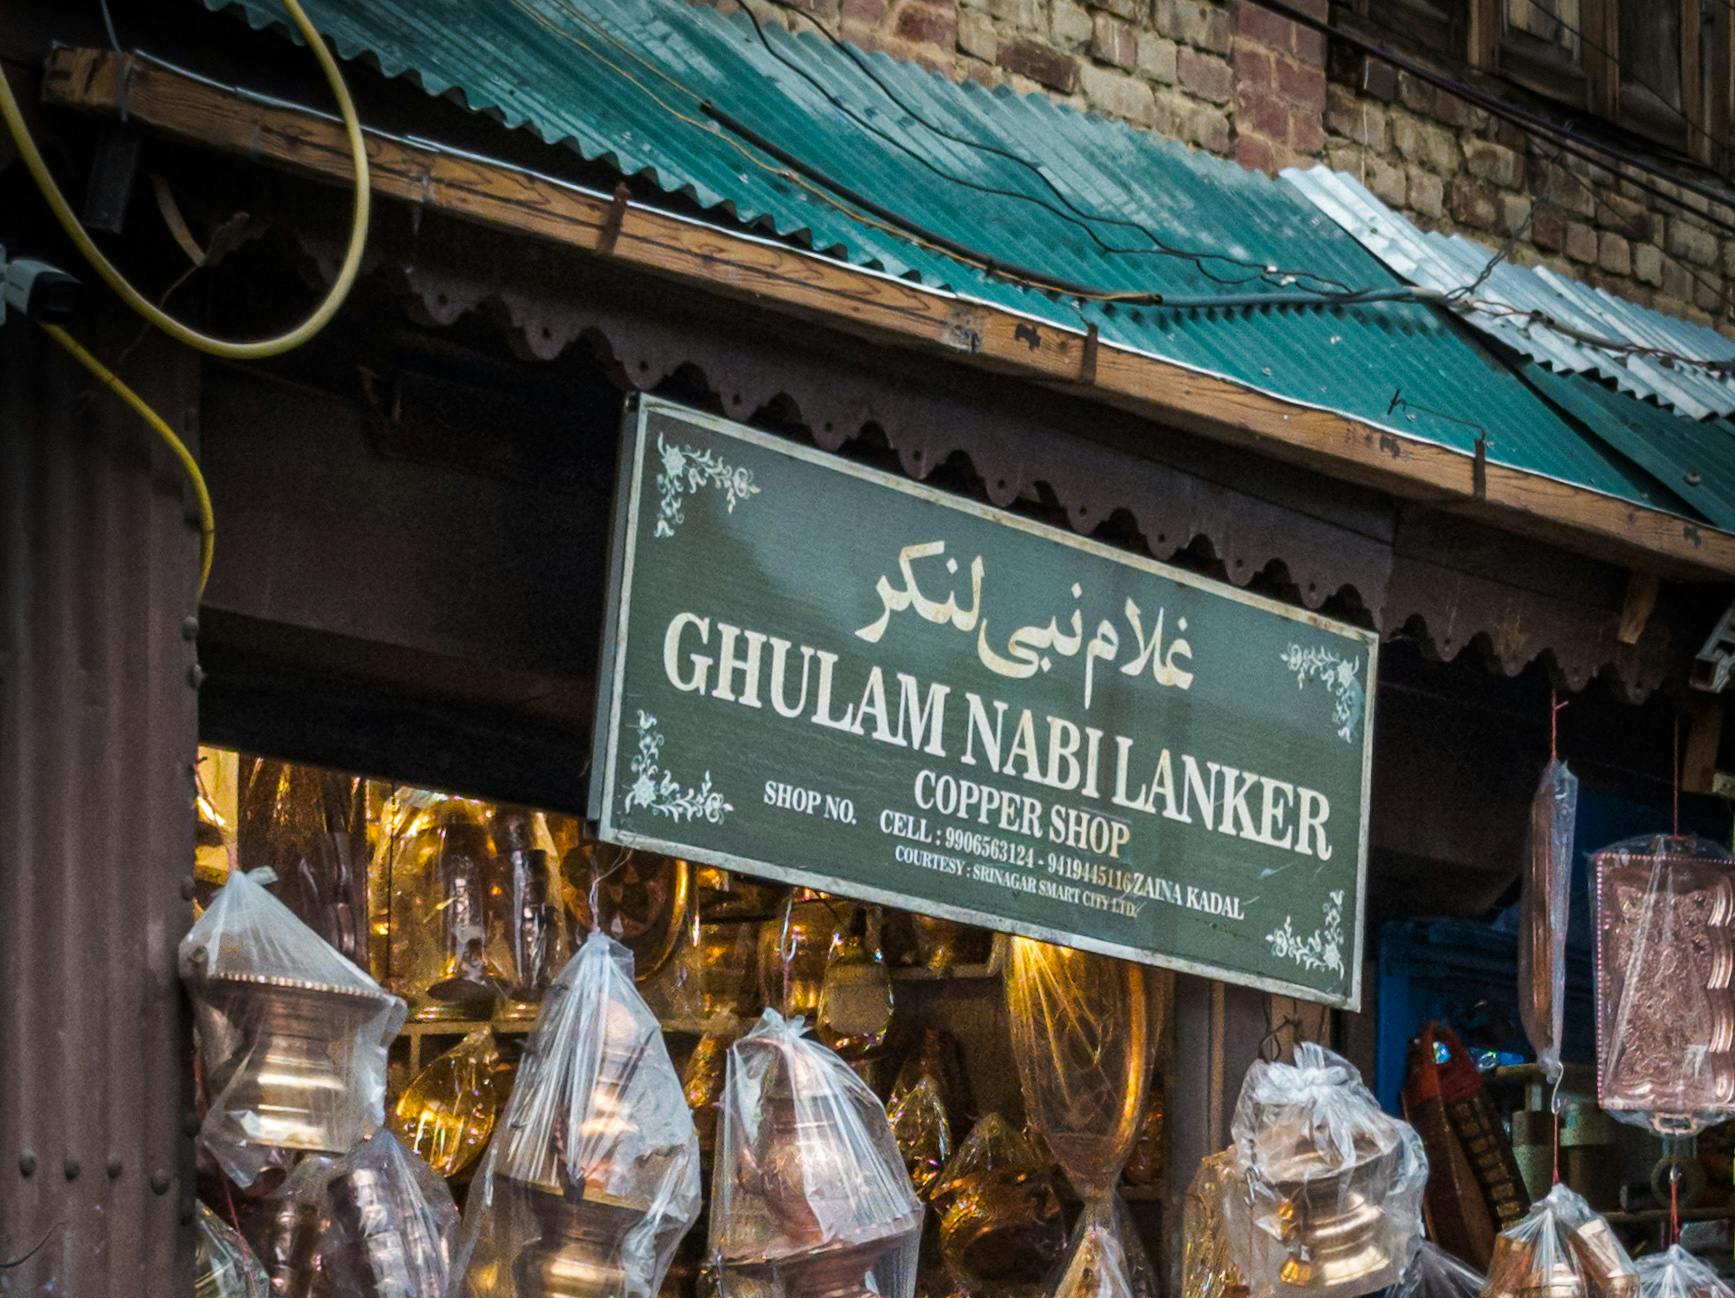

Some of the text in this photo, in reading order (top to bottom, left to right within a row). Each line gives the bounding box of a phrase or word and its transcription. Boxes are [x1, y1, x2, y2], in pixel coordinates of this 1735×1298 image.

[1085, 596, 1194, 710] غلام
[663, 612, 1333, 860] GHULAM NABI LANKER
[763, 780, 822, 815] SHOP
[824, 794, 857, 825] NO.
[880, 809, 932, 844] CELL
[945, 827, 1034, 868] 9906563124
[1133, 872, 1182, 906] ZAINA
[1186, 885, 1244, 920] KADAL
[914, 769, 1131, 858] COPPER SHOP
[895, 845, 966, 876] COURTESY
[972, 864, 1037, 894] SRINAGAR
[1038, 879, 1081, 904] SMART
[1082, 890, 1110, 911] CITY
